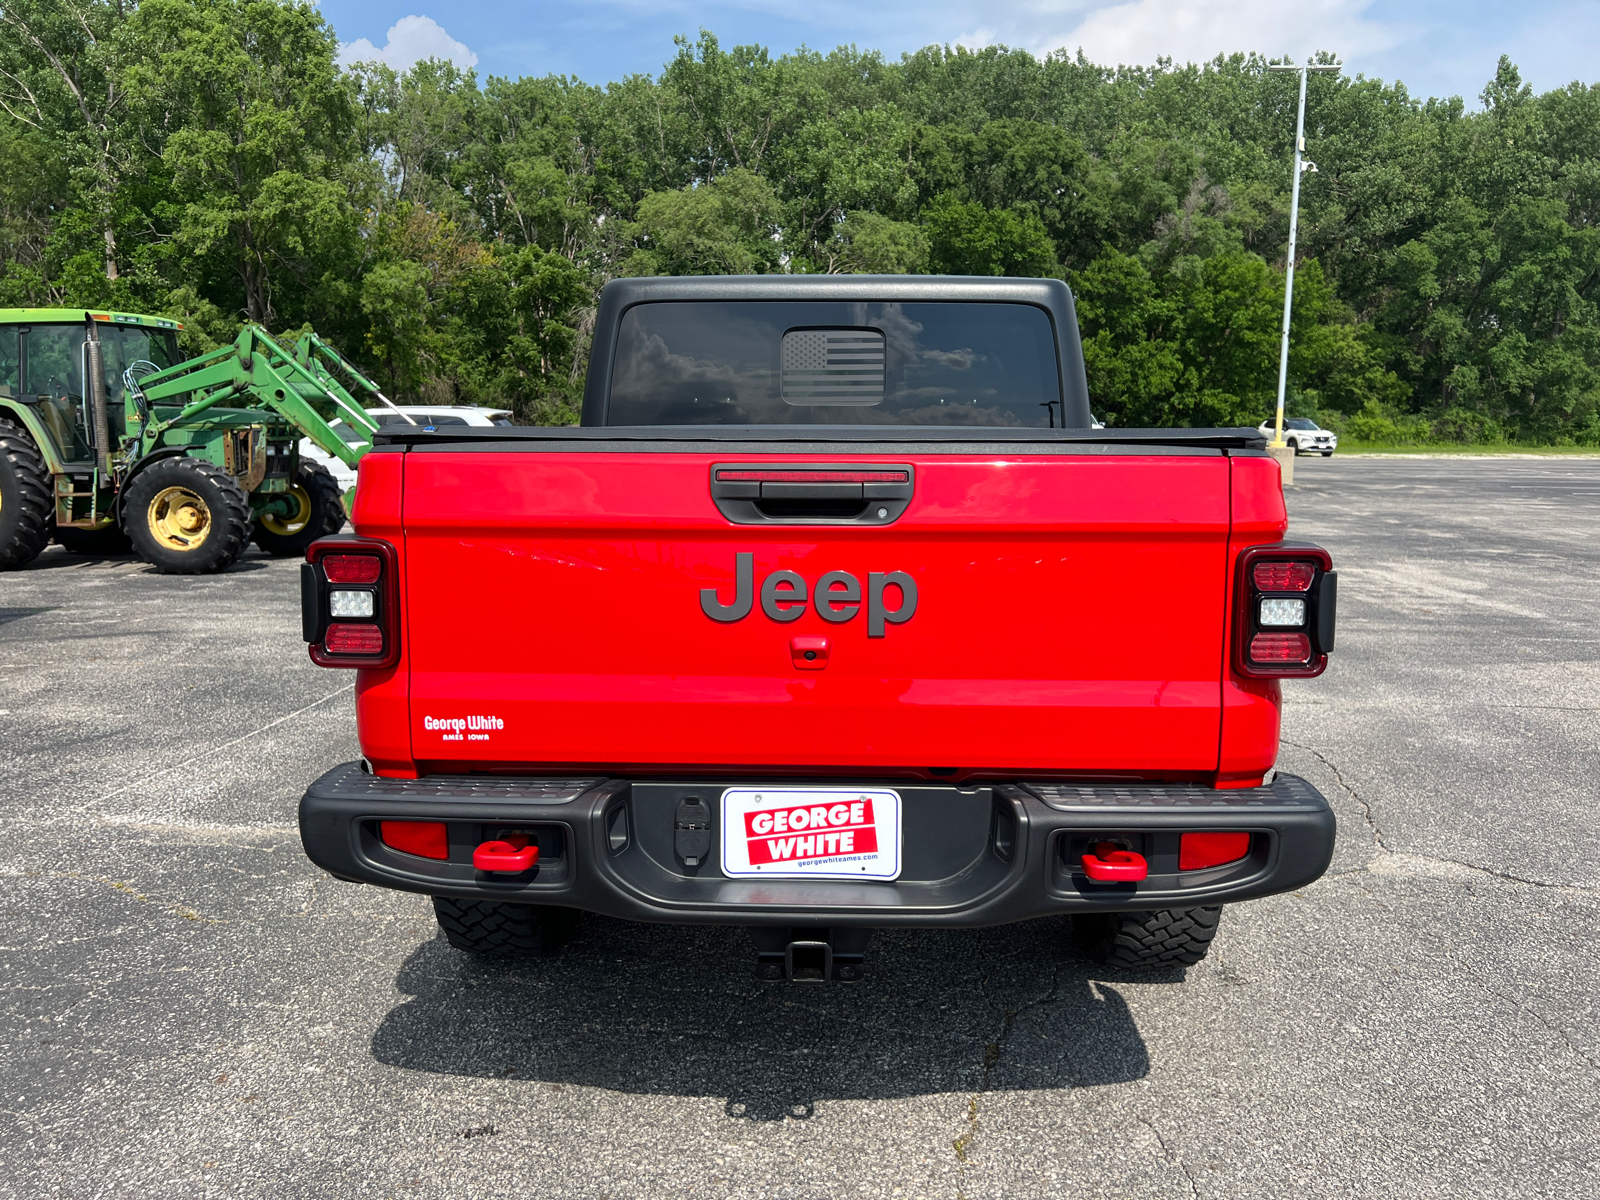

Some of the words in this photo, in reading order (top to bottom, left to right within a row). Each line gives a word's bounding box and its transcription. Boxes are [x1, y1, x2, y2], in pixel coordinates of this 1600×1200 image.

[700, 552, 918, 637] Jeep
[424, 715, 466, 734] George
[467, 715, 504, 730] White
[751, 802, 865, 834] GEORGE
[767, 831, 855, 860] WHITE
[798, 854, 879, 868] georgewhiteames.com
